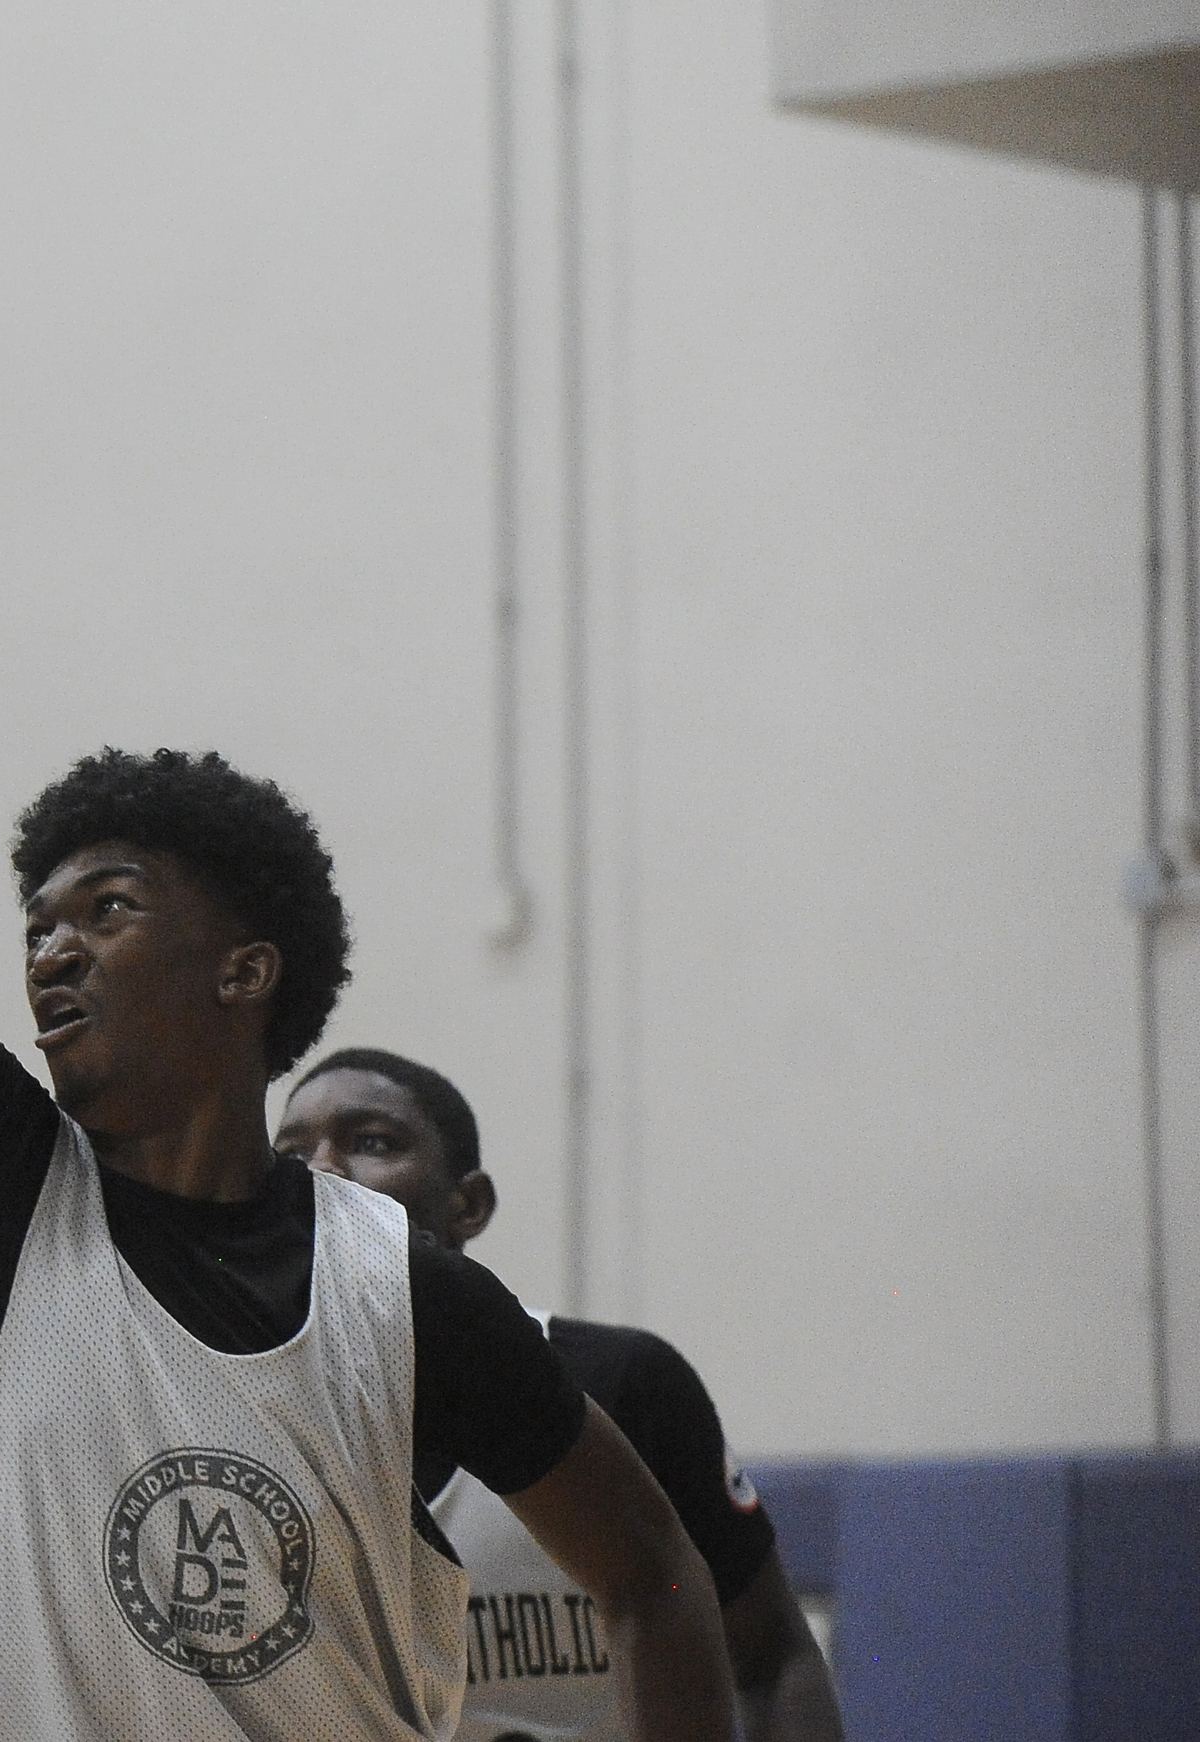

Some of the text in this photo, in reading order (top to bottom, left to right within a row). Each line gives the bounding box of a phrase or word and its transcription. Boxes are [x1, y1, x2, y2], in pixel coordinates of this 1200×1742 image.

[122, 1460, 303, 1555] MIDDLE SCHOOL
[168, 1602, 246, 1640] HOOPS
[161, 1636, 260, 1676] ADEMY
